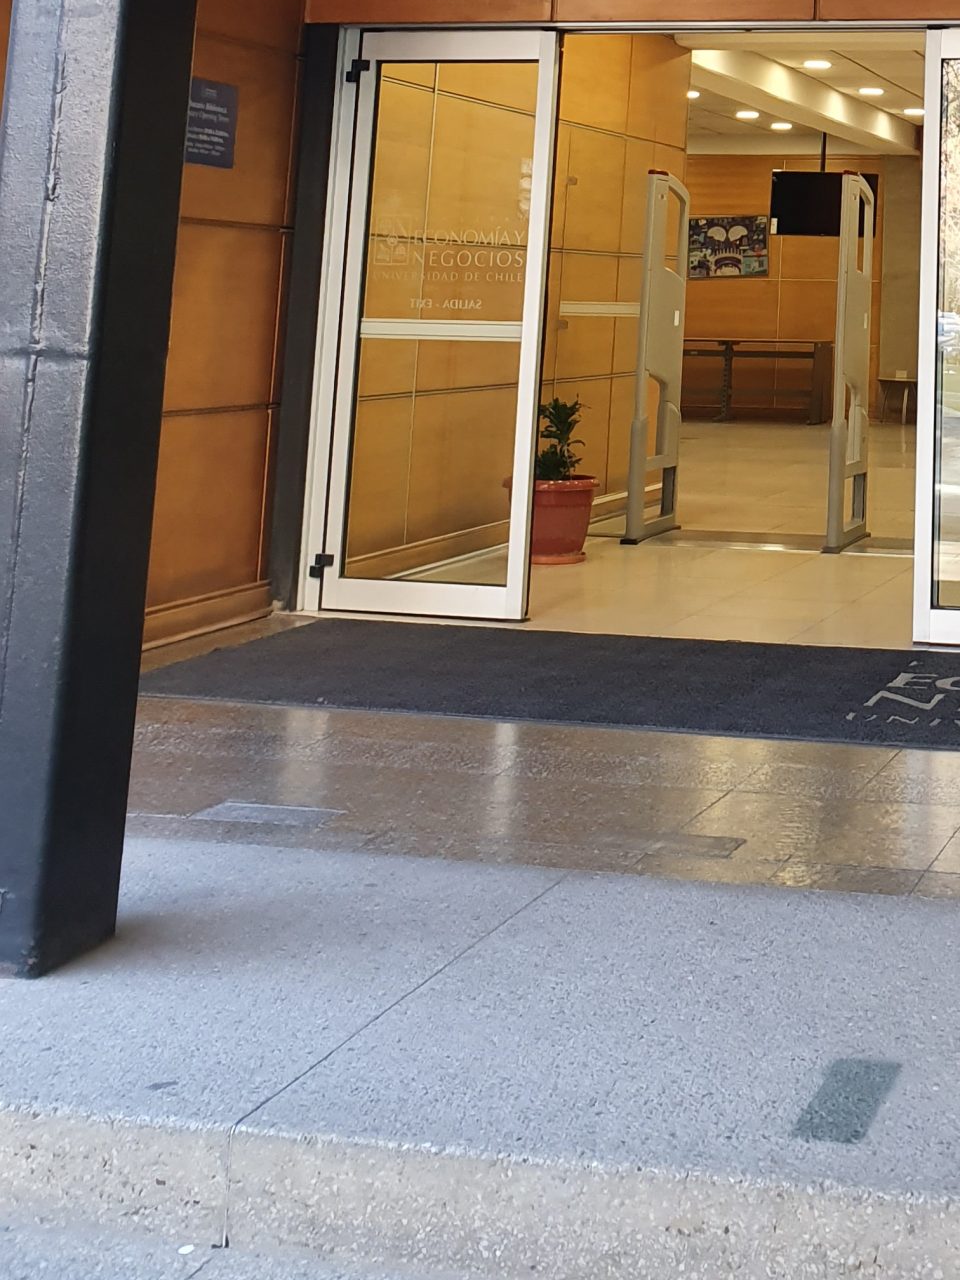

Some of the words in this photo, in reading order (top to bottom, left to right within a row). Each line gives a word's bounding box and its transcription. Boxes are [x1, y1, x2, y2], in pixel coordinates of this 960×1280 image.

[412, 249, 524, 268] NEGOCIOS
[463, 271, 481, 282] DE
[486, 271, 523, 283] CHILE
